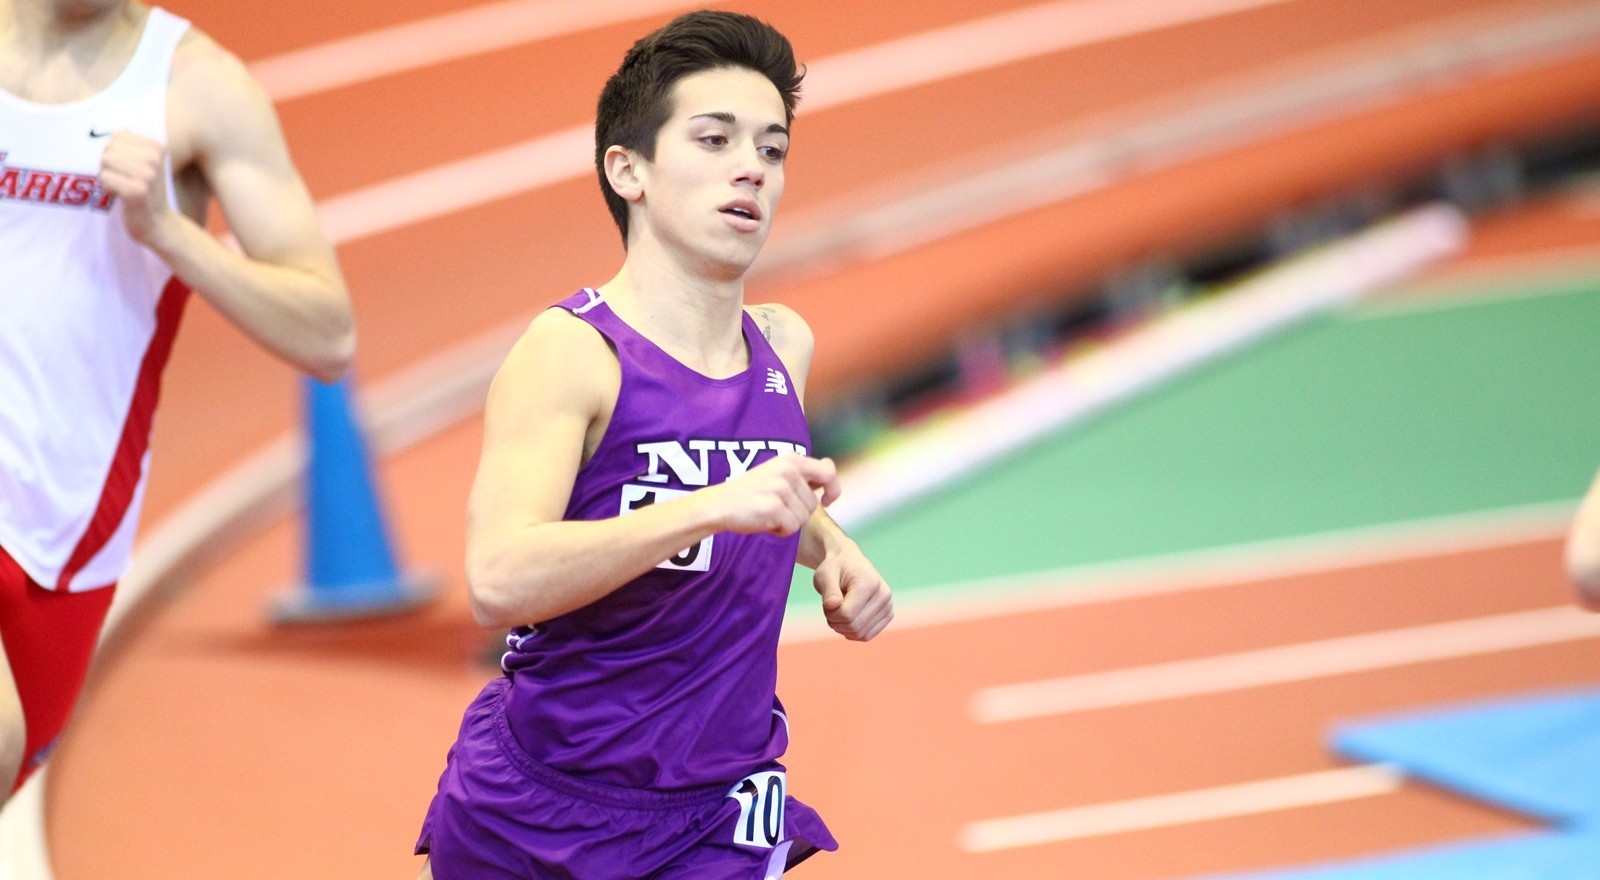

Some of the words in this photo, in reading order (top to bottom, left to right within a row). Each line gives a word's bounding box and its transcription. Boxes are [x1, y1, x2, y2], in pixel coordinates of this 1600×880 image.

[0, 153, 115, 212] ARIS
[637, 440, 806, 486] NY
[736, 775, 782, 846] 10
